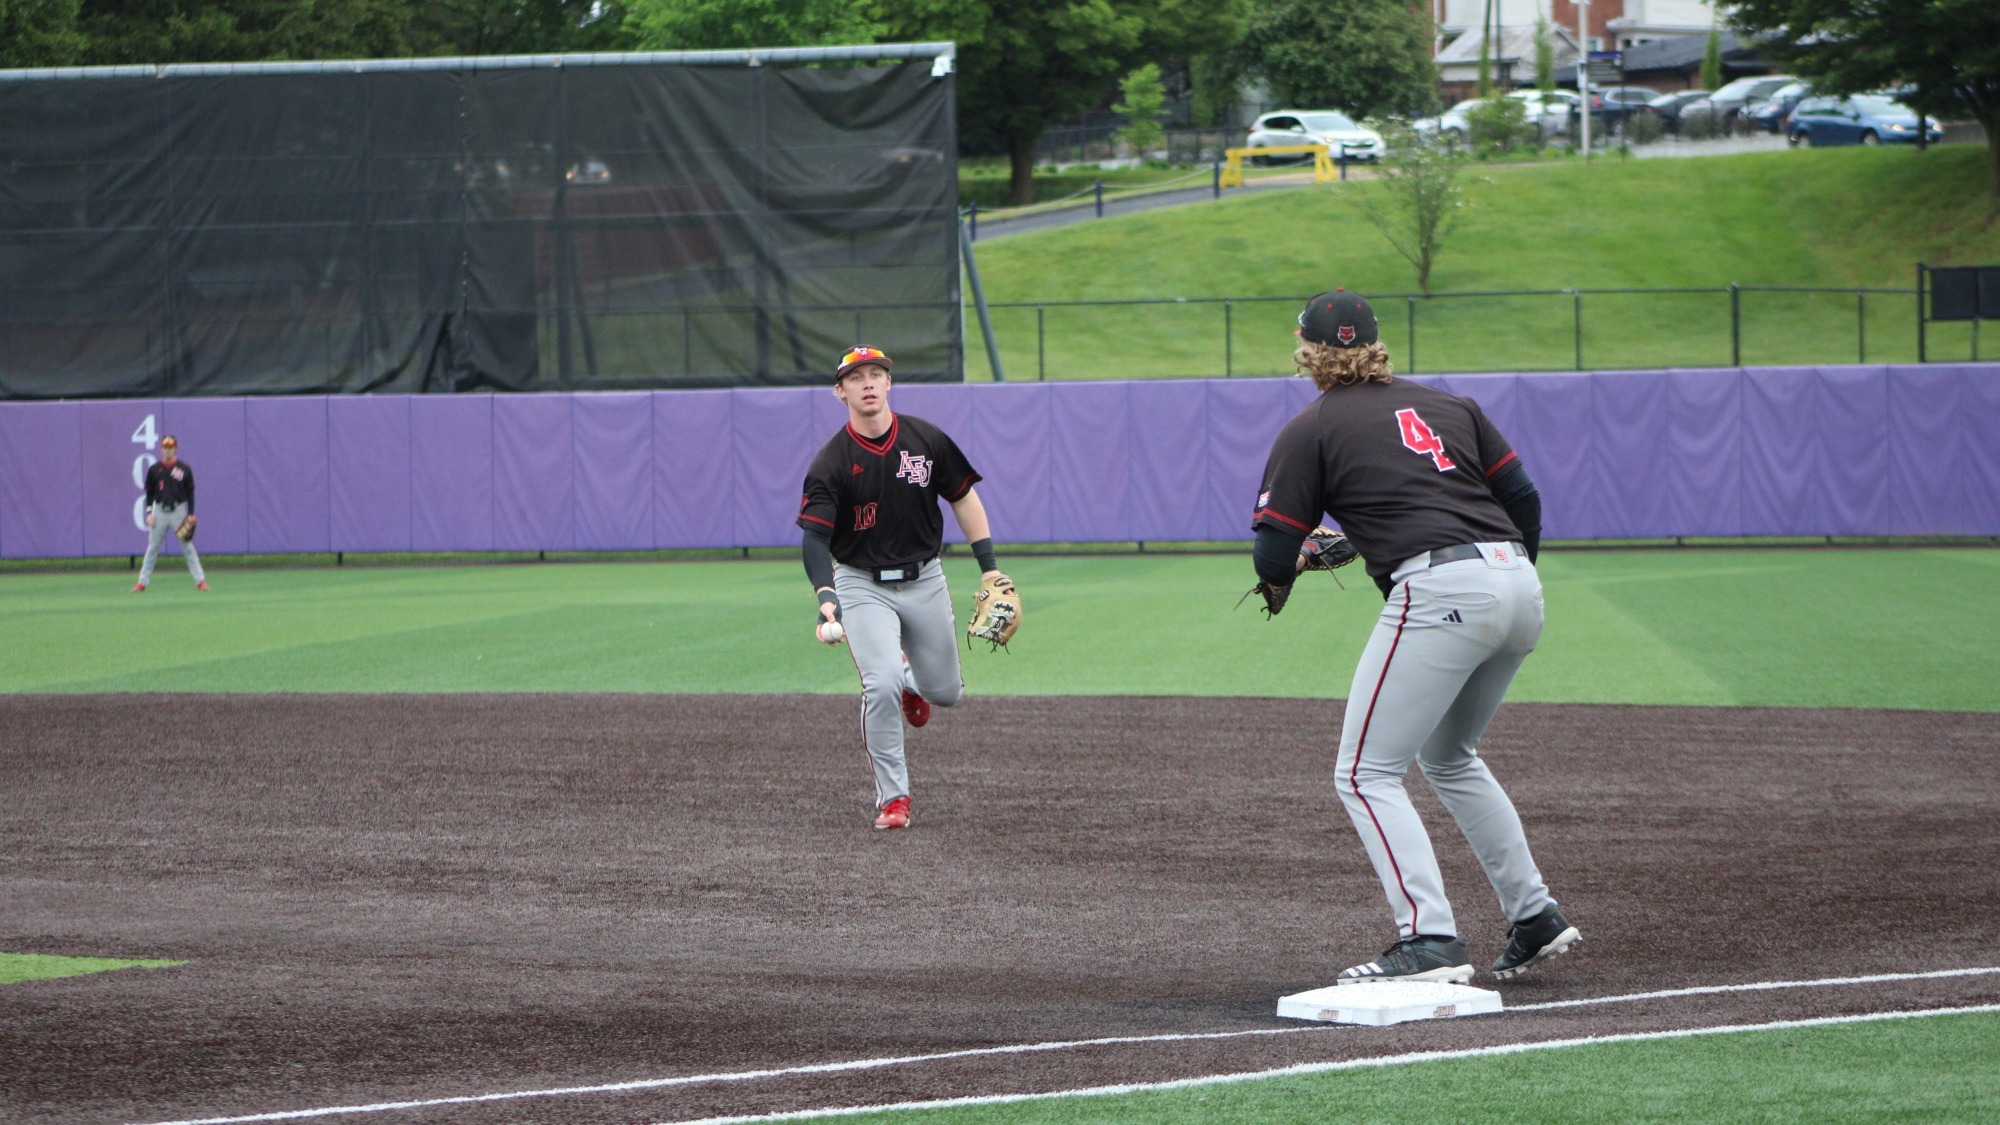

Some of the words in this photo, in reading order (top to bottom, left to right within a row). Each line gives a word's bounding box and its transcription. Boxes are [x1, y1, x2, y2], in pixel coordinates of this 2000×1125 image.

[1395, 408, 1456, 472] 4
[896, 451, 933, 487] ASU
[854, 502, 877, 531] 10
[1317, 1008, 1340, 1021] JMU
[1433, 1004, 1456, 1018] JMU
